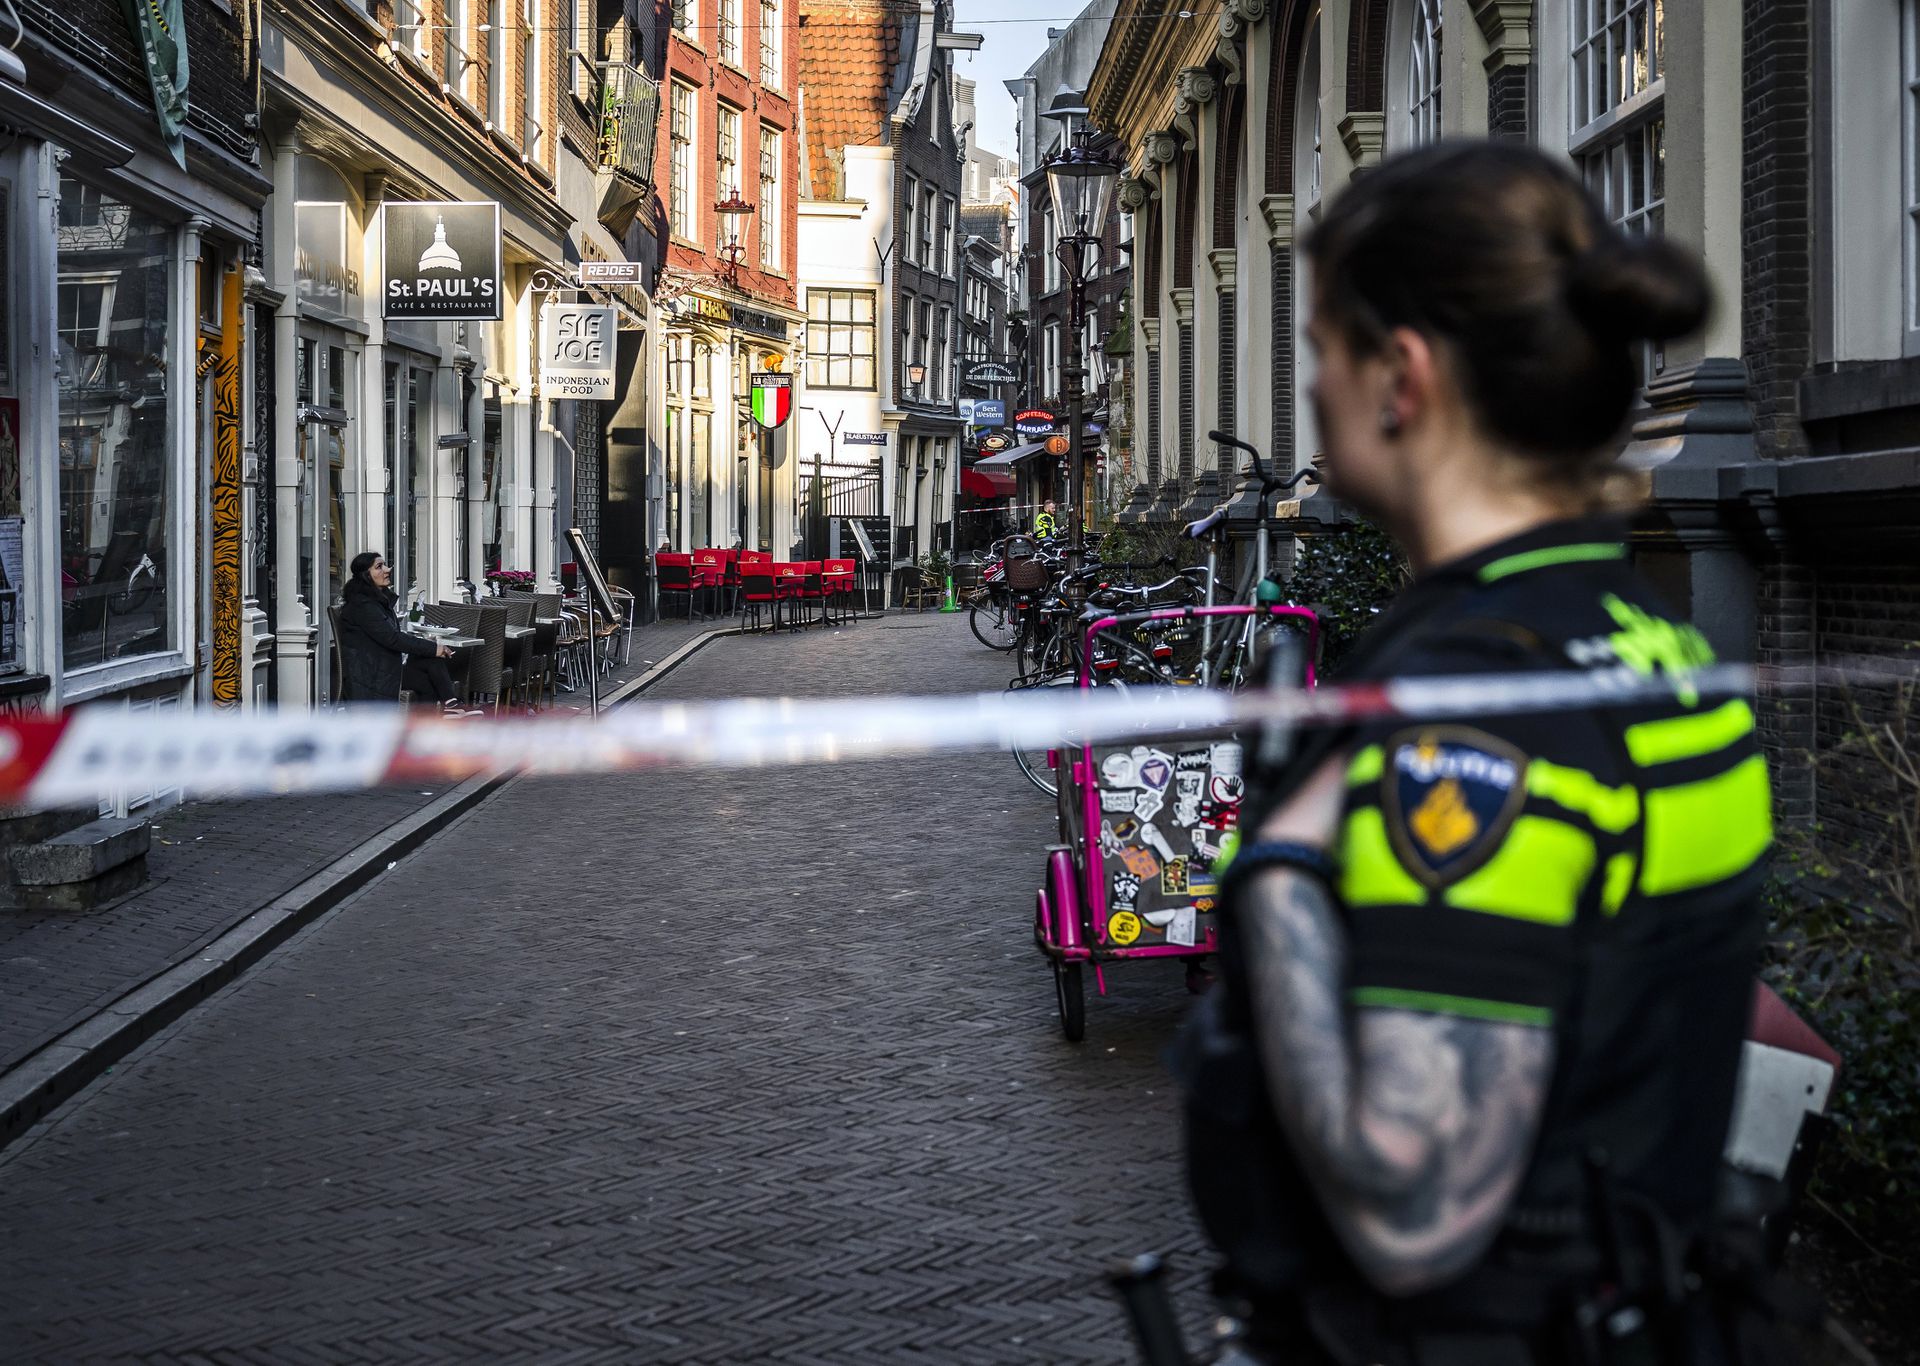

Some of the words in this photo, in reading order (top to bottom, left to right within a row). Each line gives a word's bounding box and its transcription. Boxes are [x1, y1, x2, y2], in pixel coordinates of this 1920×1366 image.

[587, 265, 635, 276] REJOES
[388, 279, 414, 297] St.
[416, 277, 494, 297] PAUL'S
[391, 301, 414, 309] CAFÉ
[559, 313, 604, 339] SIE
[554, 340, 604, 364] JOE
[546, 375, 610, 386] INDONESIAN
[562, 386, 593, 395] FOOD
[976, 410, 1003, 418] Western
[1015, 423, 1054, 433] BARRAKA
